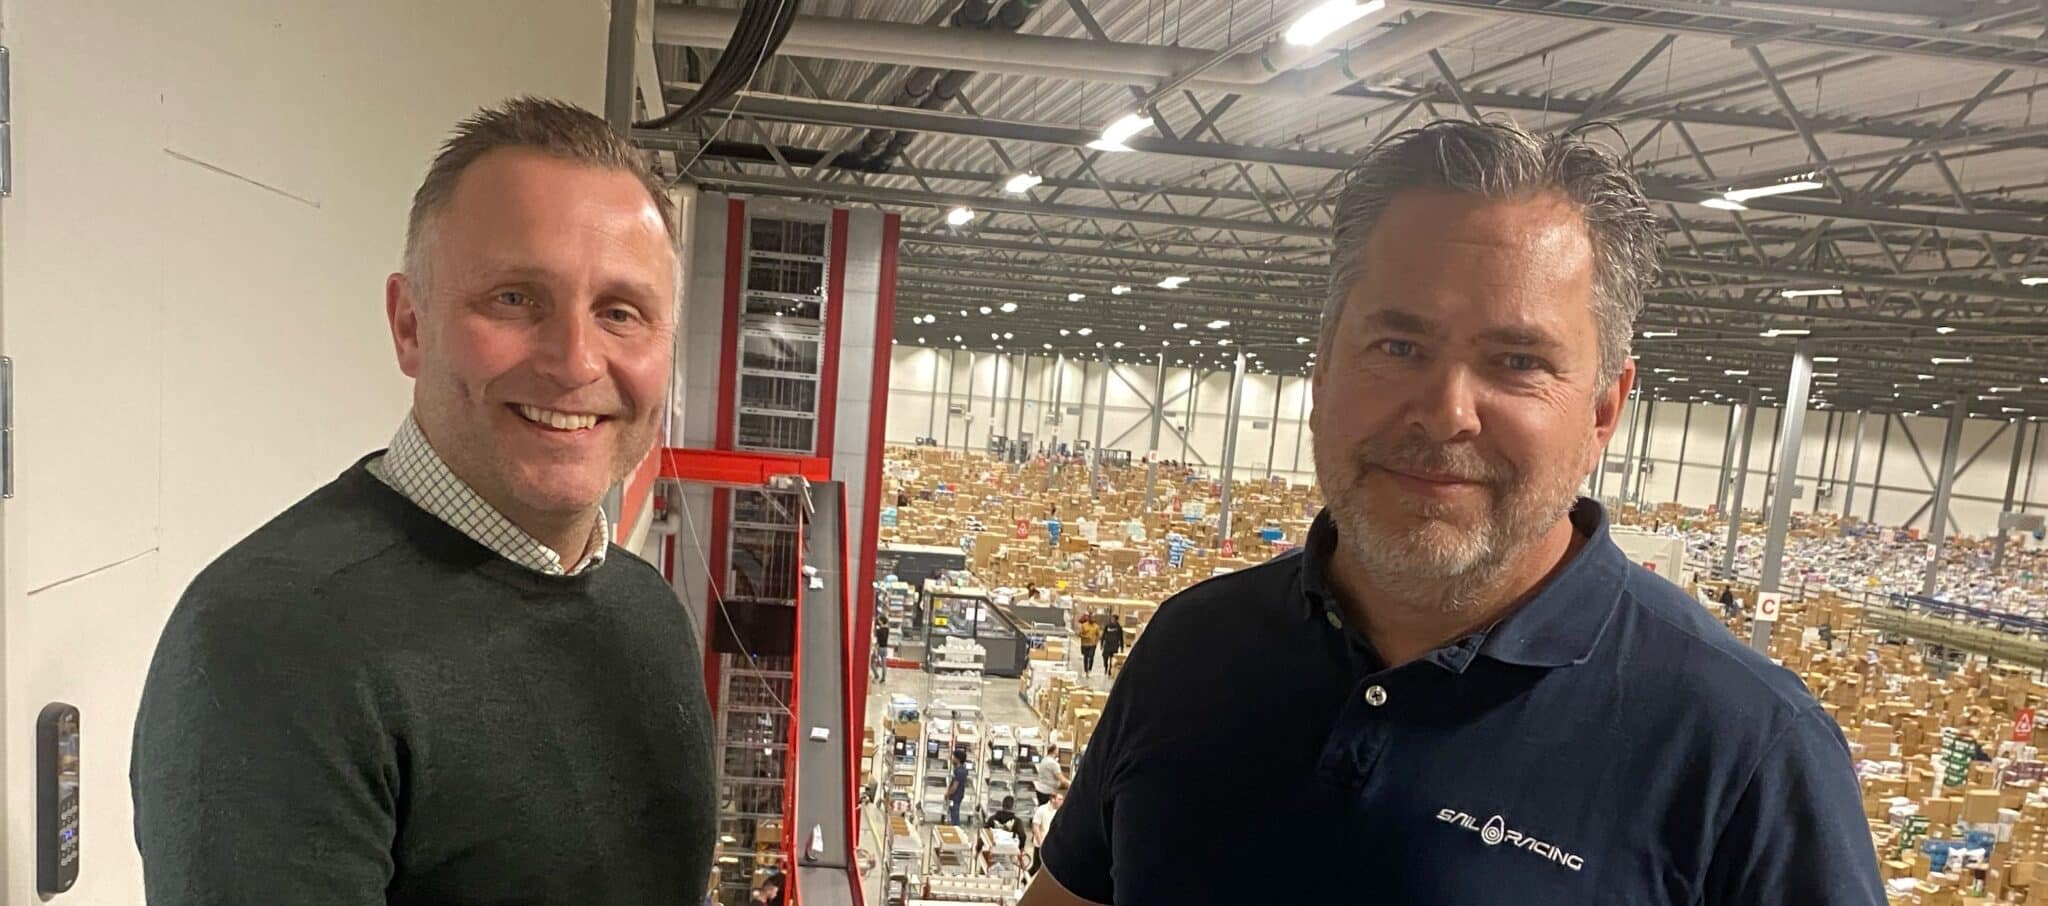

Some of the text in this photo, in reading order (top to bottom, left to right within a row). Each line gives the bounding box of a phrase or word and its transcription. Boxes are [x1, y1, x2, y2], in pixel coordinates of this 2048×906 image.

[1762, 599, 1775, 615] C
[1436, 808, 1584, 871] SAIL RACING
